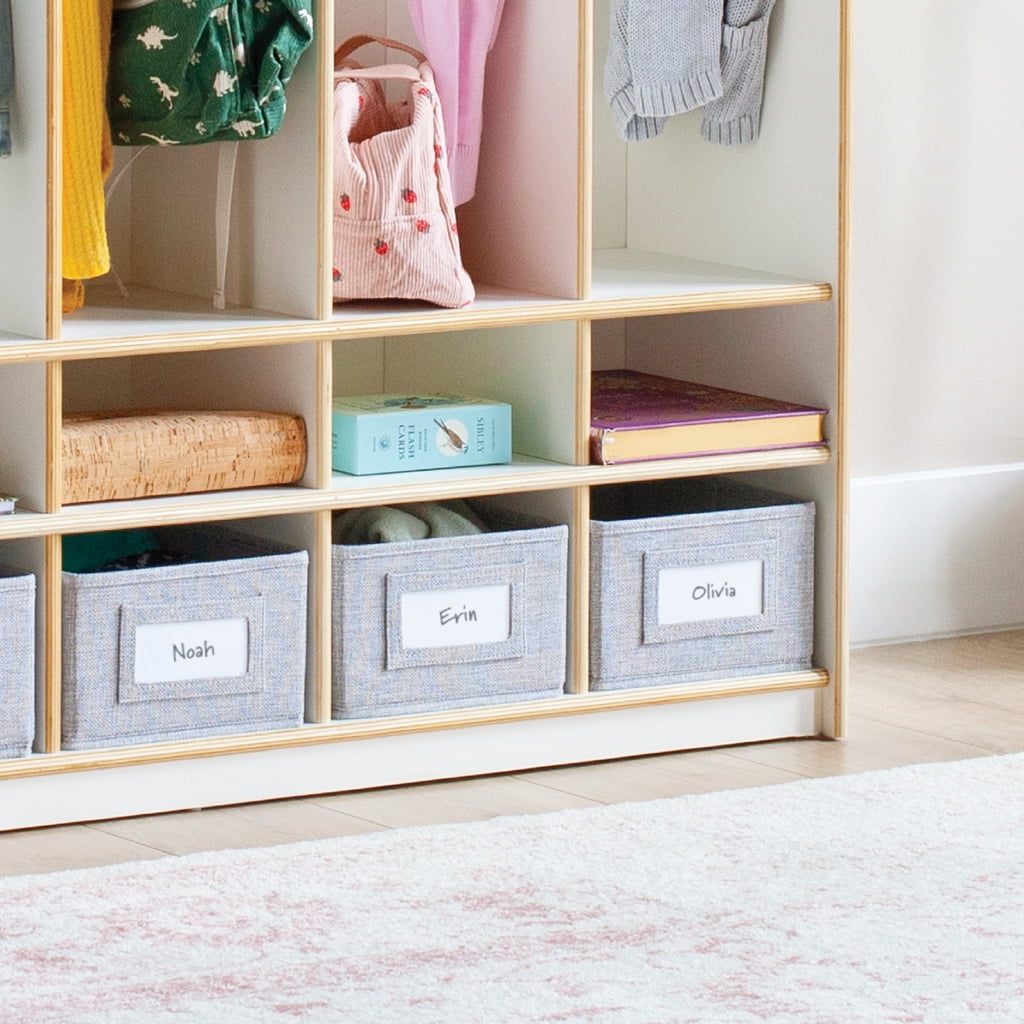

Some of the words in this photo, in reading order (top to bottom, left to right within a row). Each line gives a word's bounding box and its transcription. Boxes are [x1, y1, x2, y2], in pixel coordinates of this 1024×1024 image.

[398, 424, 406, 460] CARDS
[477, 417, 485, 453] SIBLEY
[691, 581, 737, 601] Olivia
[439, 604, 478, 626] Erin
[172, 639, 216, 663] Noah
